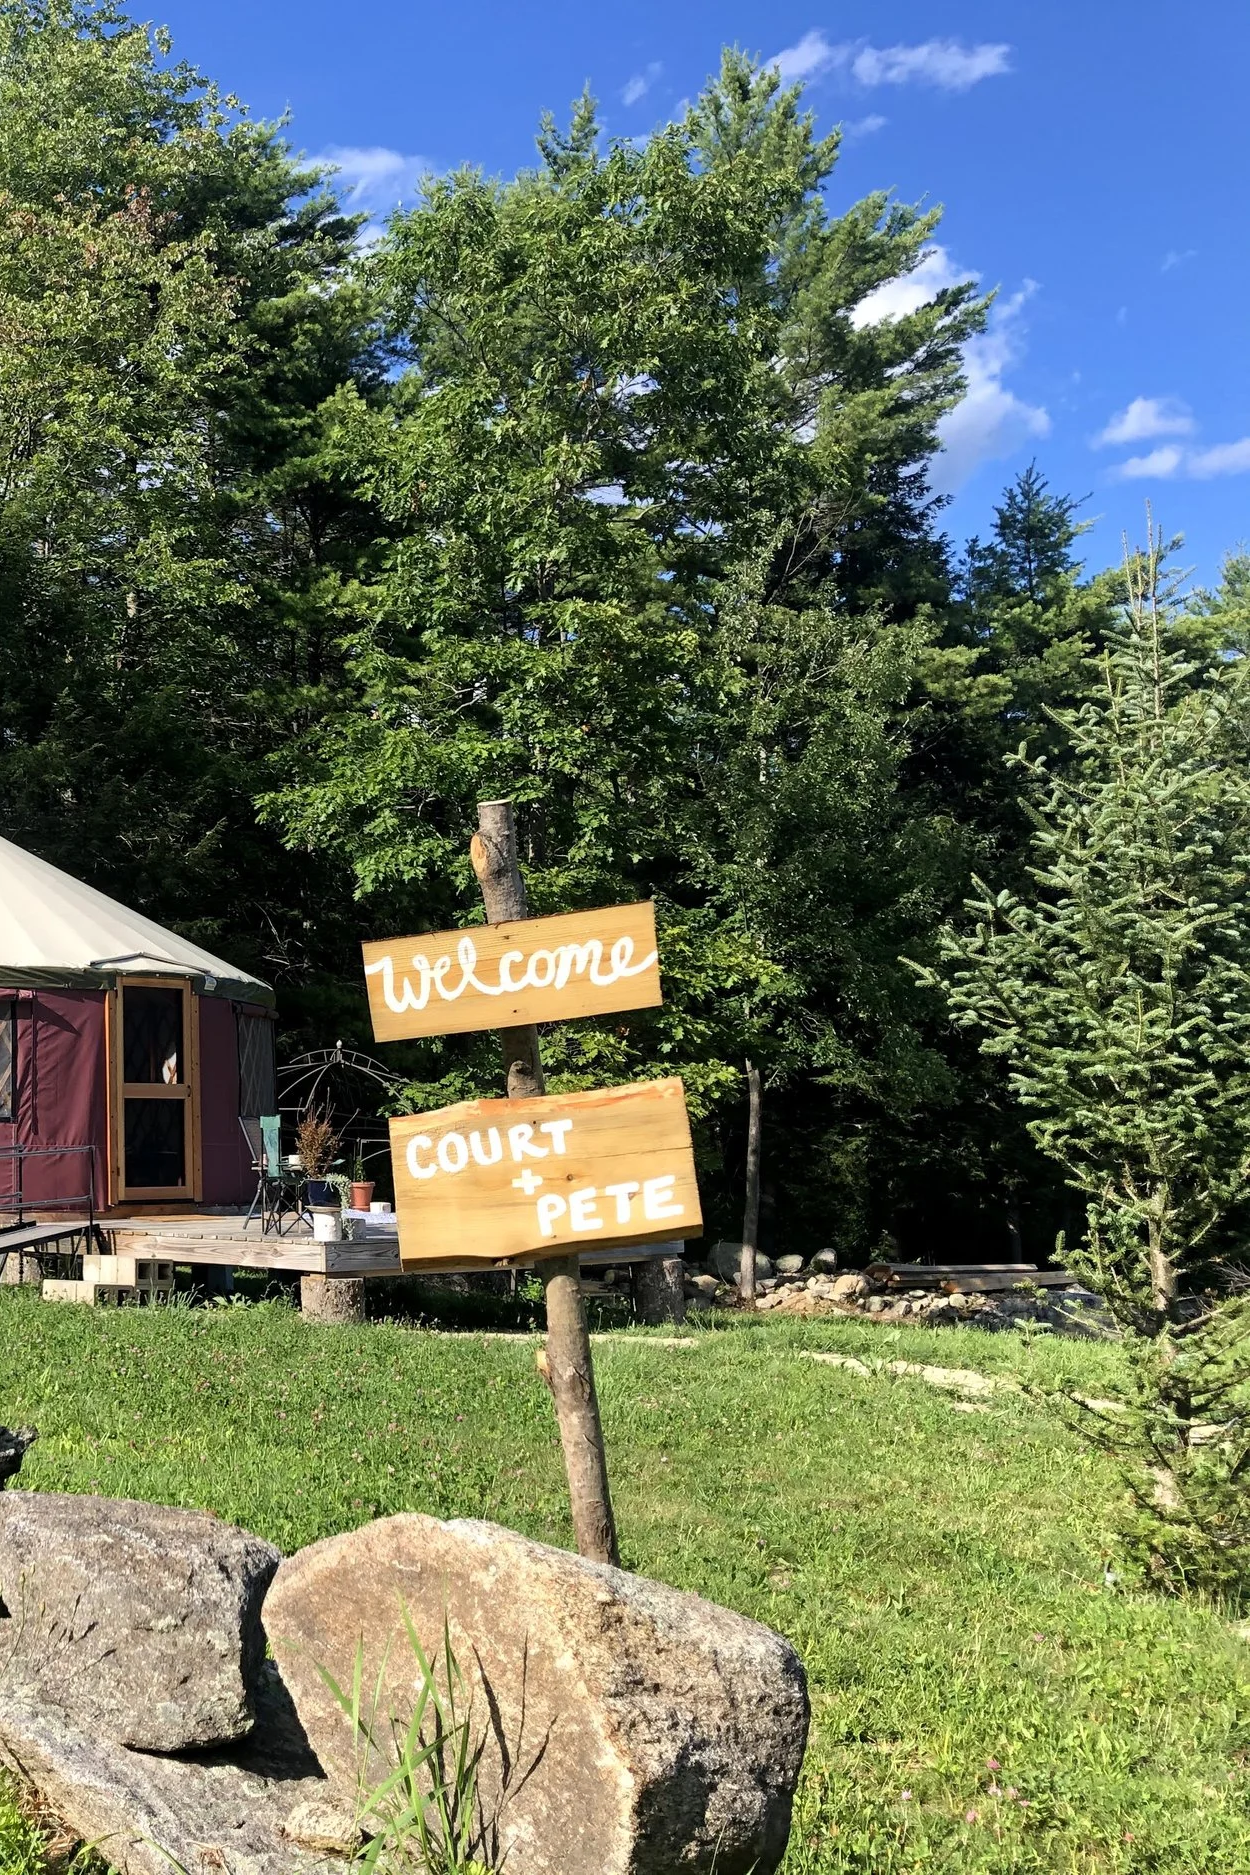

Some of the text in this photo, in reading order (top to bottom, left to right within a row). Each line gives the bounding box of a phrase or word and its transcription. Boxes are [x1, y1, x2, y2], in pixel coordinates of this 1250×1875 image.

[364, 936, 659, 1014] Welcome
[405, 1118, 574, 1180] COURT
[511, 1168, 543, 1196] +
[535, 1174, 685, 1237] PETE
